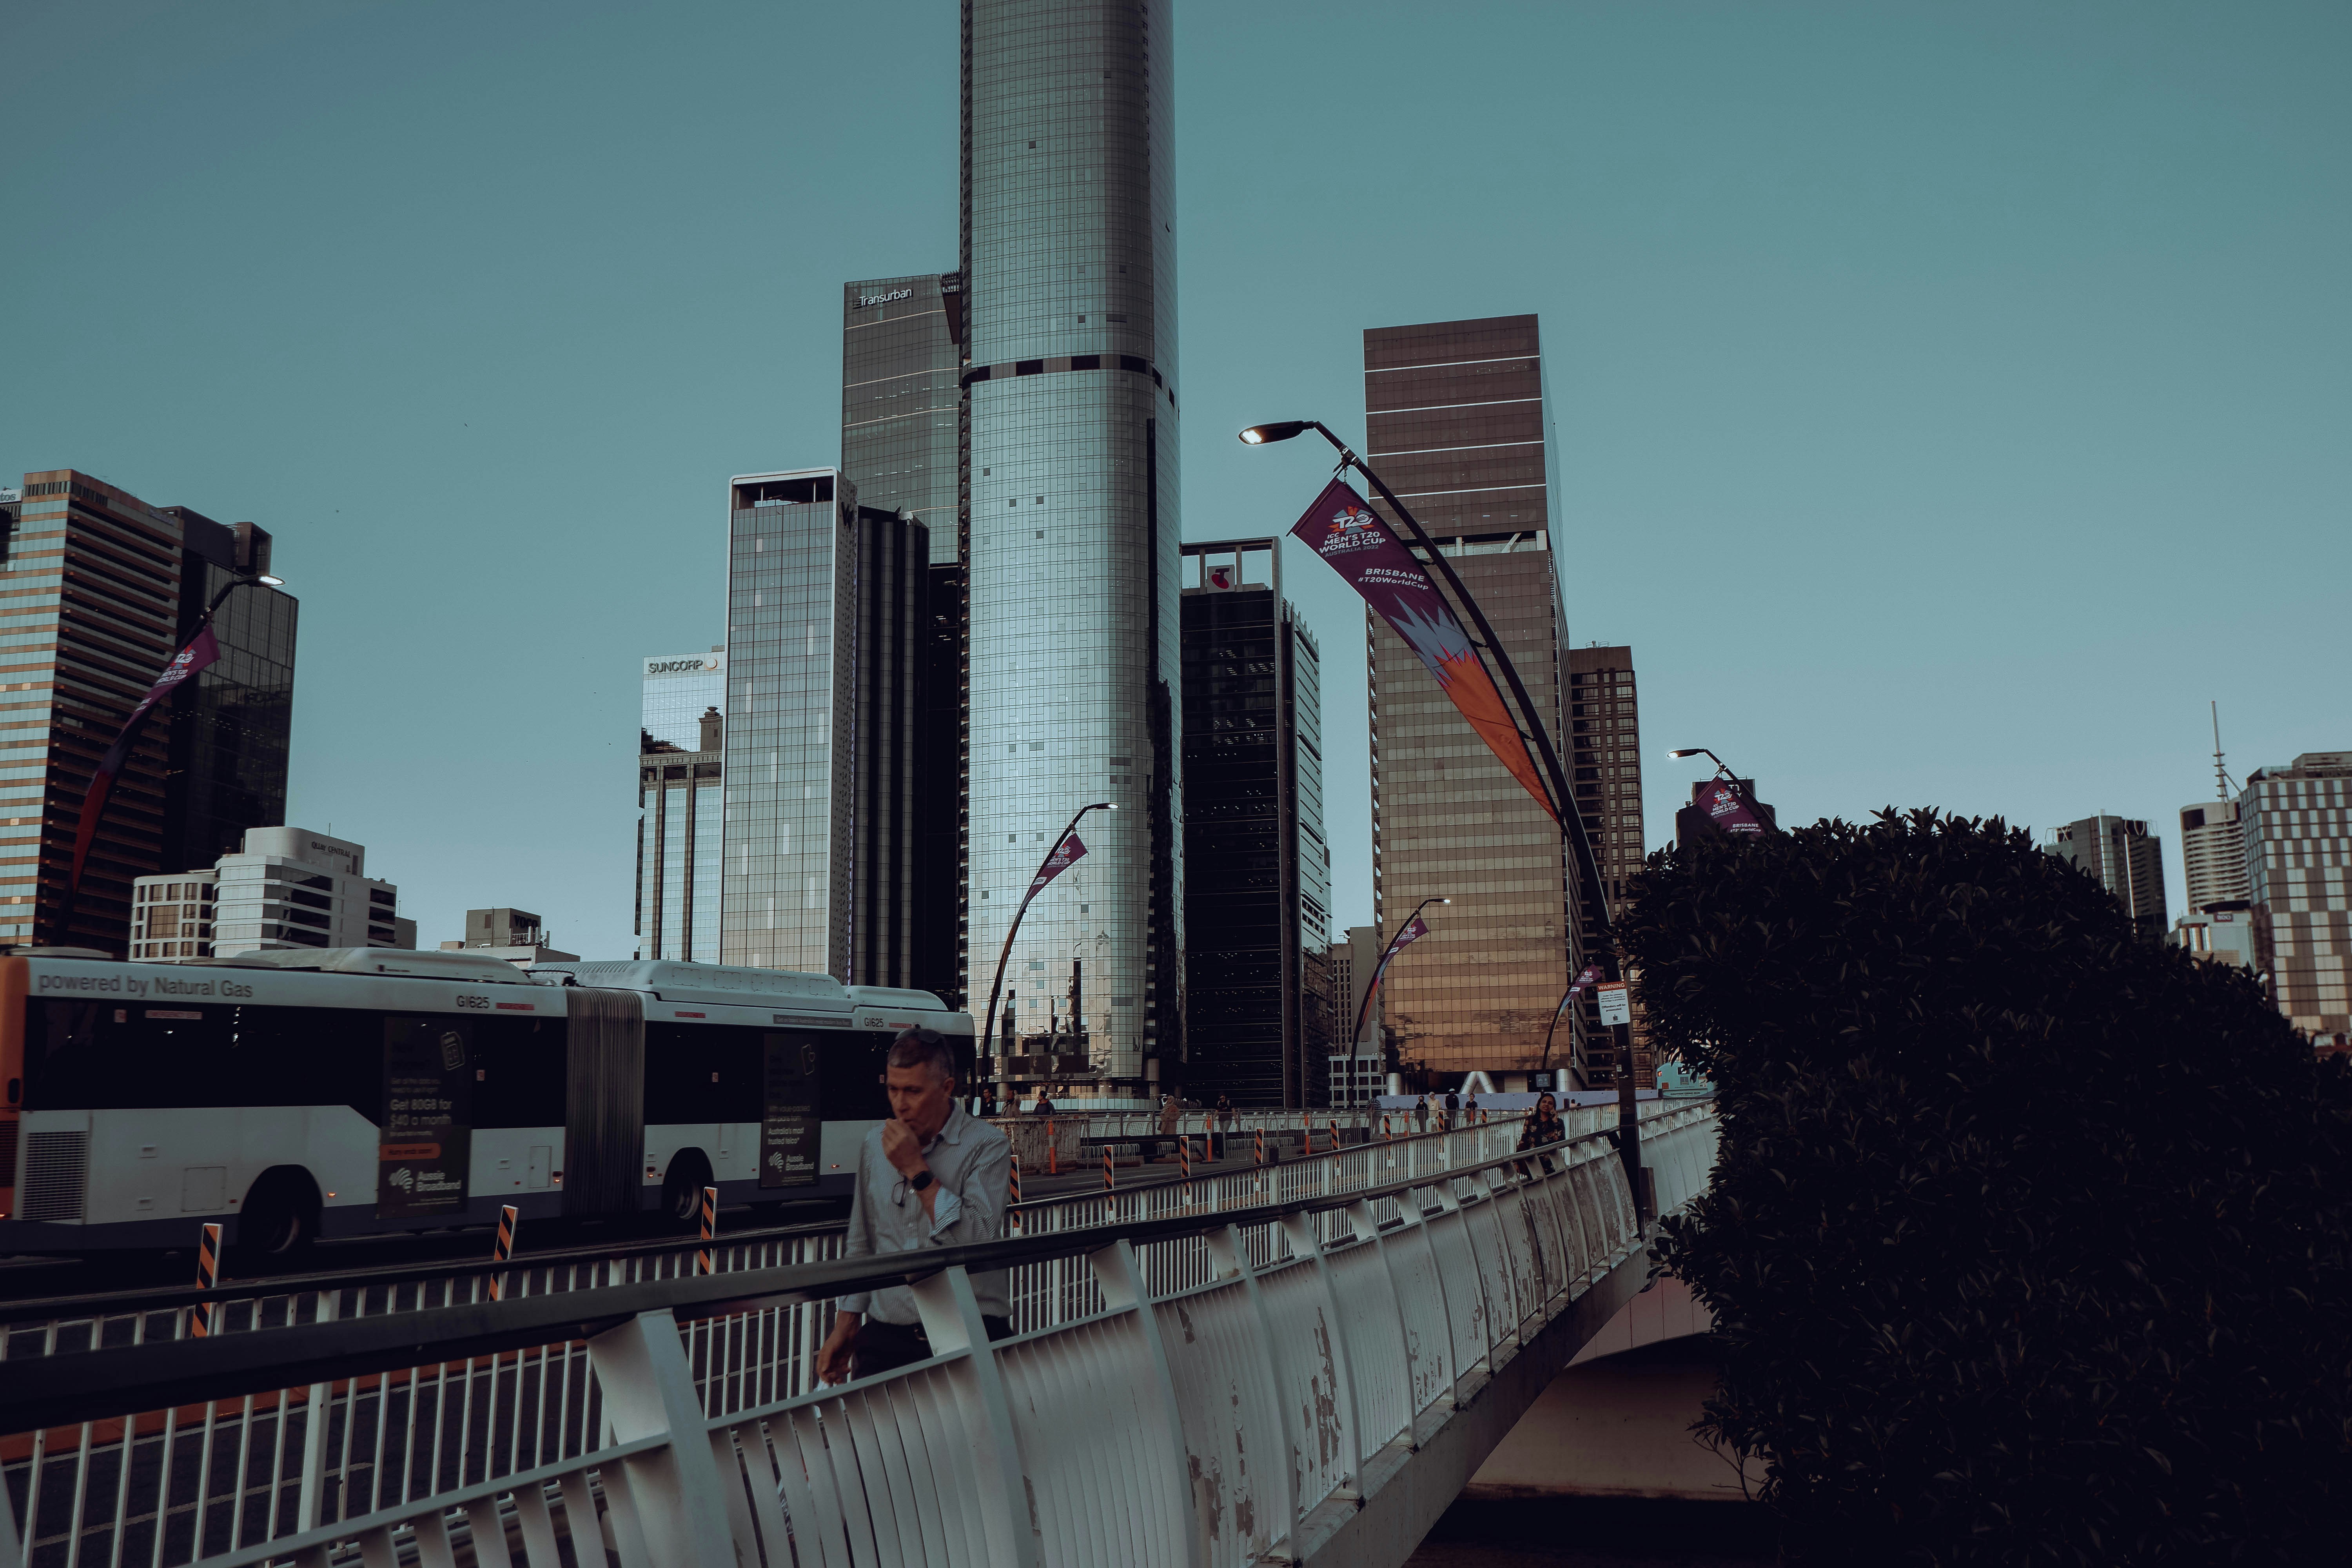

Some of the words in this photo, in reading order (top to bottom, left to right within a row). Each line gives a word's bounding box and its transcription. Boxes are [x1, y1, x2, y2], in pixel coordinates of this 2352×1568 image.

[859, 288, 913, 307] Transurban
[1325, 534, 1358, 546] MEN'S
[1319, 541, 1360, 554] WORLD
[1325, 546, 1361, 557] AUSTRALIA
[1365, 568, 1425, 582] BRISBANE
[1357, 577, 1429, 590] #T20WorldCup
[648, 659, 703, 673] SUNCORP
[1710, 808, 1729, 817] WORLD
[311, 841, 327, 851] QUAY
[328, 846, 351, 858] CENTRAL
[39, 975, 121, 993] powered
[127, 975, 149, 998] by
[156, 976, 215, 996] Natural
[220, 980, 253, 998] Gas
[390, 1098, 409, 1111] Get
[438, 1098, 452, 1111] for
[390, 1113, 409, 1128] $40
[410, 1116, 419, 1125] a
[420, 1114, 452, 1126] month
[786, 1154, 804, 1164] Aussie
[785, 1161, 815, 1171] Broadband
[417, 1170, 446, 1181] Aussie
[416, 1179, 462, 1192] Broadband
